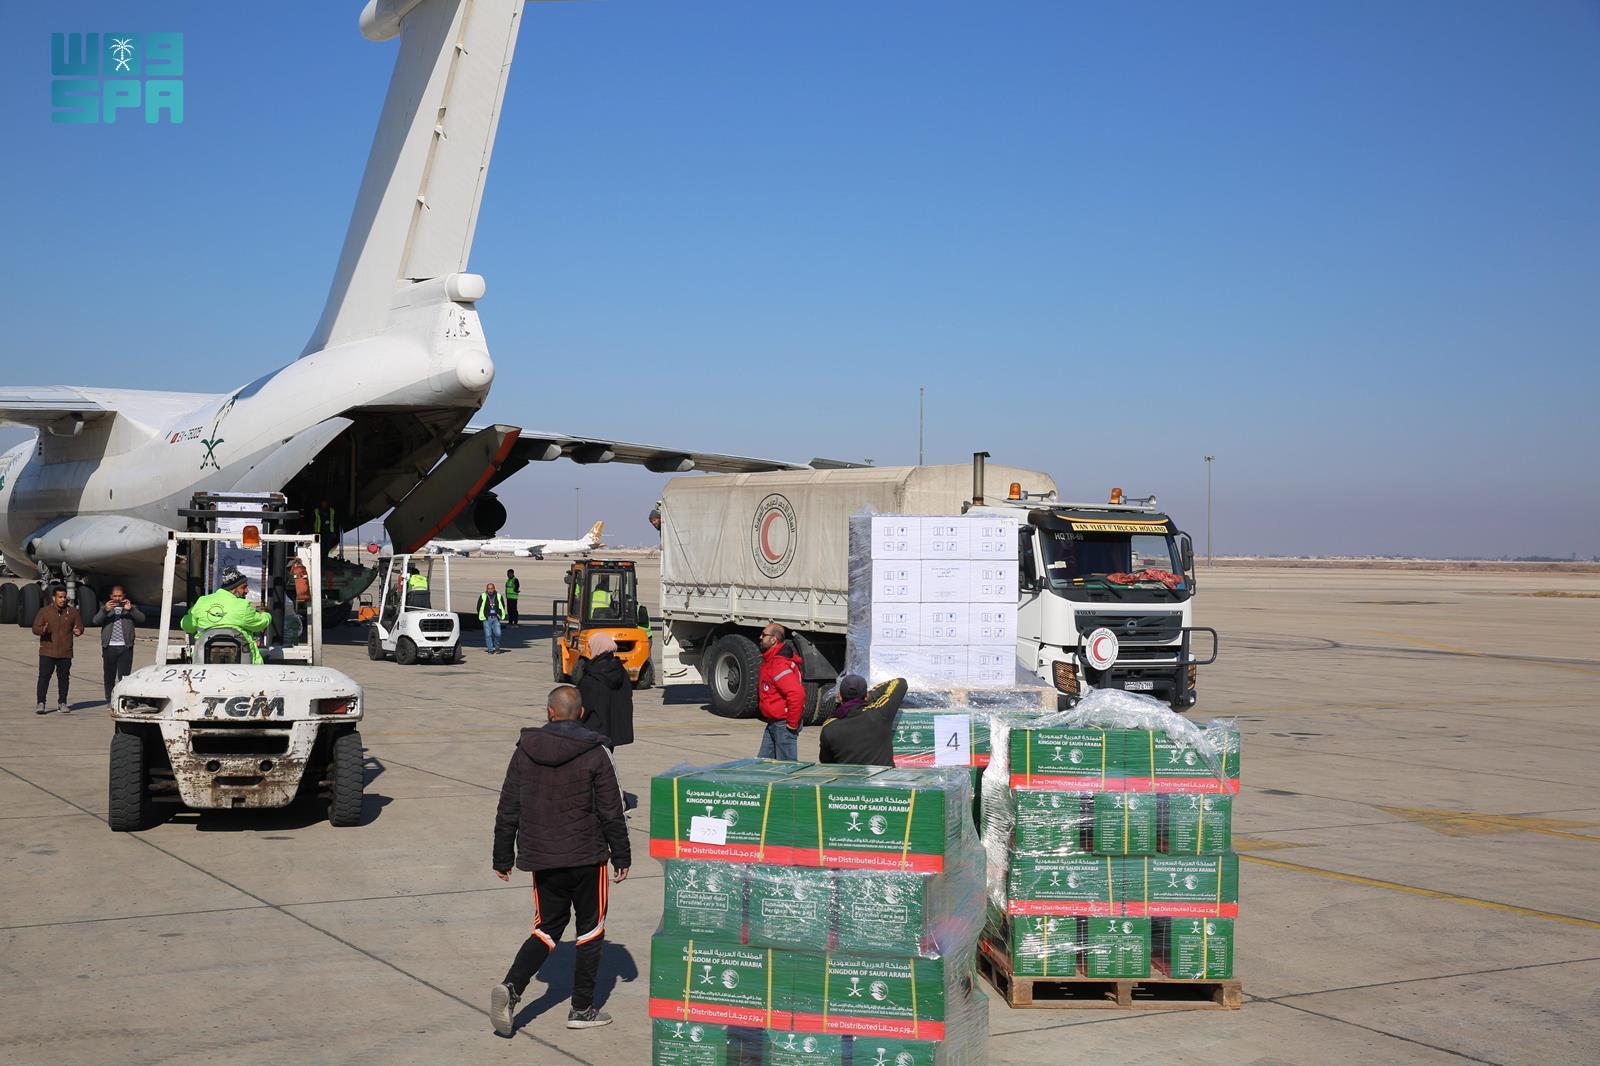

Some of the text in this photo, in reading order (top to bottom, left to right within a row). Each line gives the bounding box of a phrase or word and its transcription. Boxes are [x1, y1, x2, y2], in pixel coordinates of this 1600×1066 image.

[202, 696, 284, 717] TCM
[947, 732, 960, 751] 4
[692, 847, 728, 856] Distributed
[838, 856, 876, 865] Distributed
[683, 956, 712, 964] KGDOM
[692, 1008, 728, 1018] Distributed
[840, 1021, 878, 1031] Distributed
